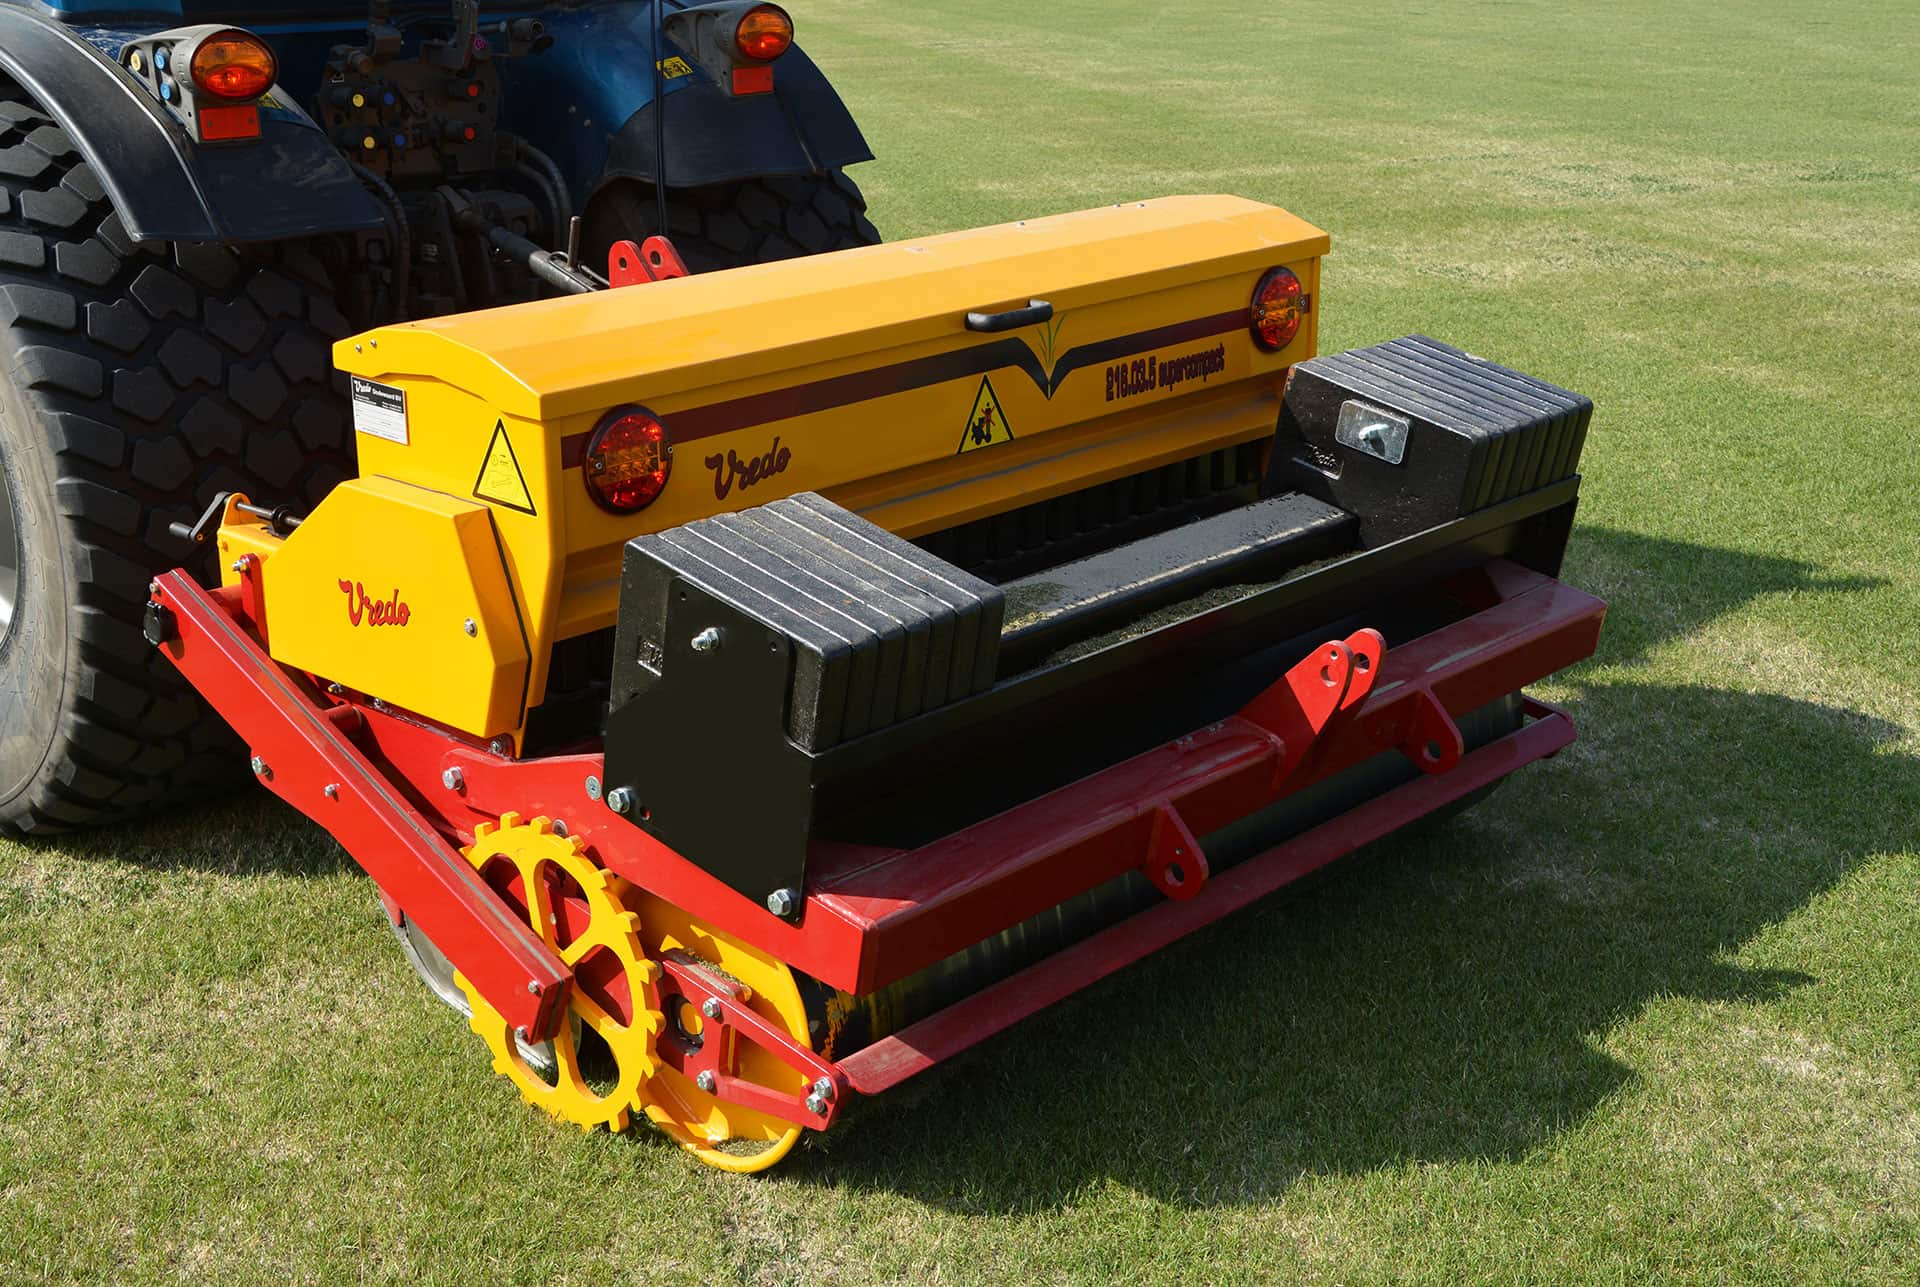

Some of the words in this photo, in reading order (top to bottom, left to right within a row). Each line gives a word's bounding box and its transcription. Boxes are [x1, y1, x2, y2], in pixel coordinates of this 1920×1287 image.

[1158, 341, 1225, 392] supercompact
[704, 436, 791, 501] Vredo
[338, 577, 411, 627] Vredo
